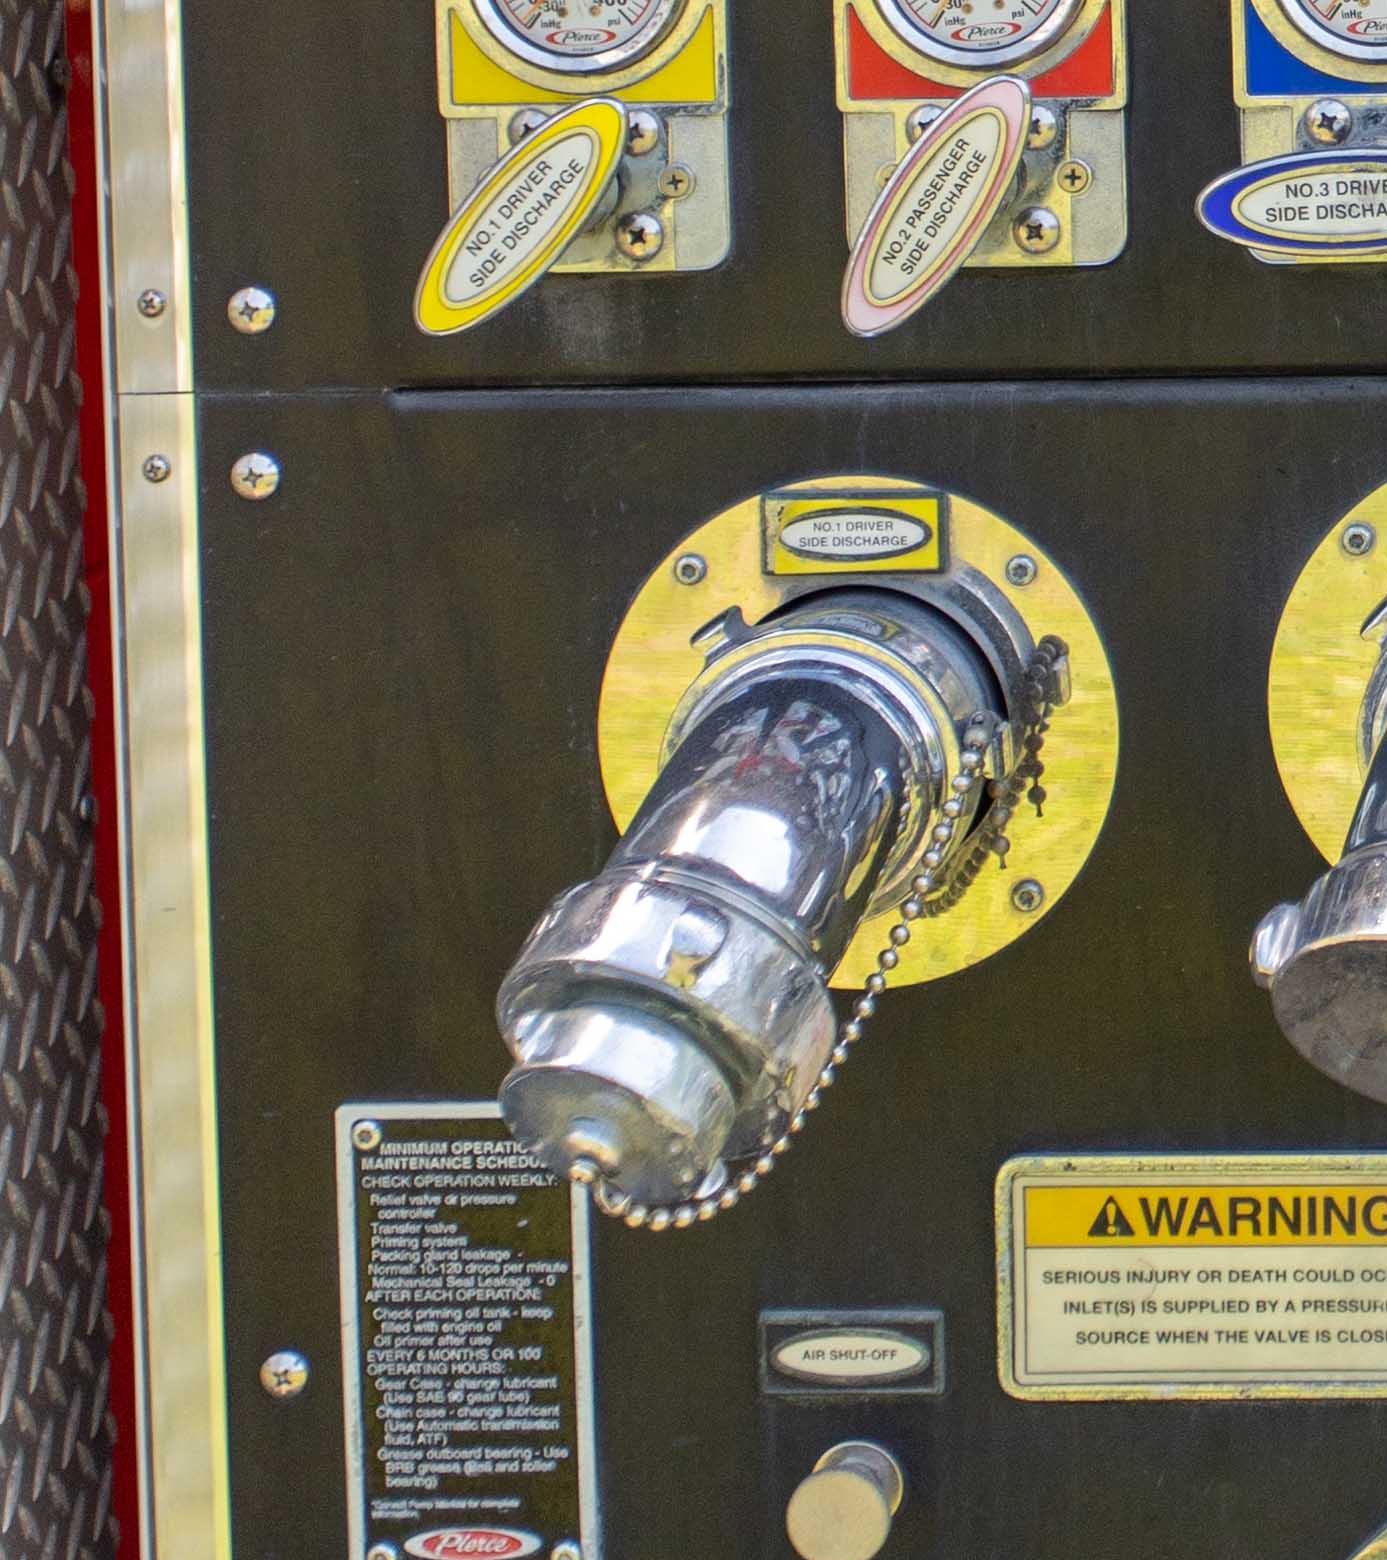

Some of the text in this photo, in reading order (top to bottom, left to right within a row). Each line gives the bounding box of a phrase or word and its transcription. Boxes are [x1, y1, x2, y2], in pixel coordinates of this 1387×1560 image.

[1285, 182, 1331, 199] NO.3
[1266, 205, 1309, 223] SIDE
[813, 520, 893, 532] NO.1 DRIVER
[799, 534, 907, 547] SIDE DISCHARGE
[362, 1175, 558, 1188] CHECK OPERATION WEEKLY:
[1043, 1270, 1121, 1284] SERIOUS
[1126, 1270, 1191, 1283] INJURY
[1197, 1270, 1221, 1283] OR
[1228, 1270, 1286, 1283] DEATH
[1292, 1269, 1354, 1283] COULD
[802, 1349, 898, 1360] AIR SHUT-OFF
